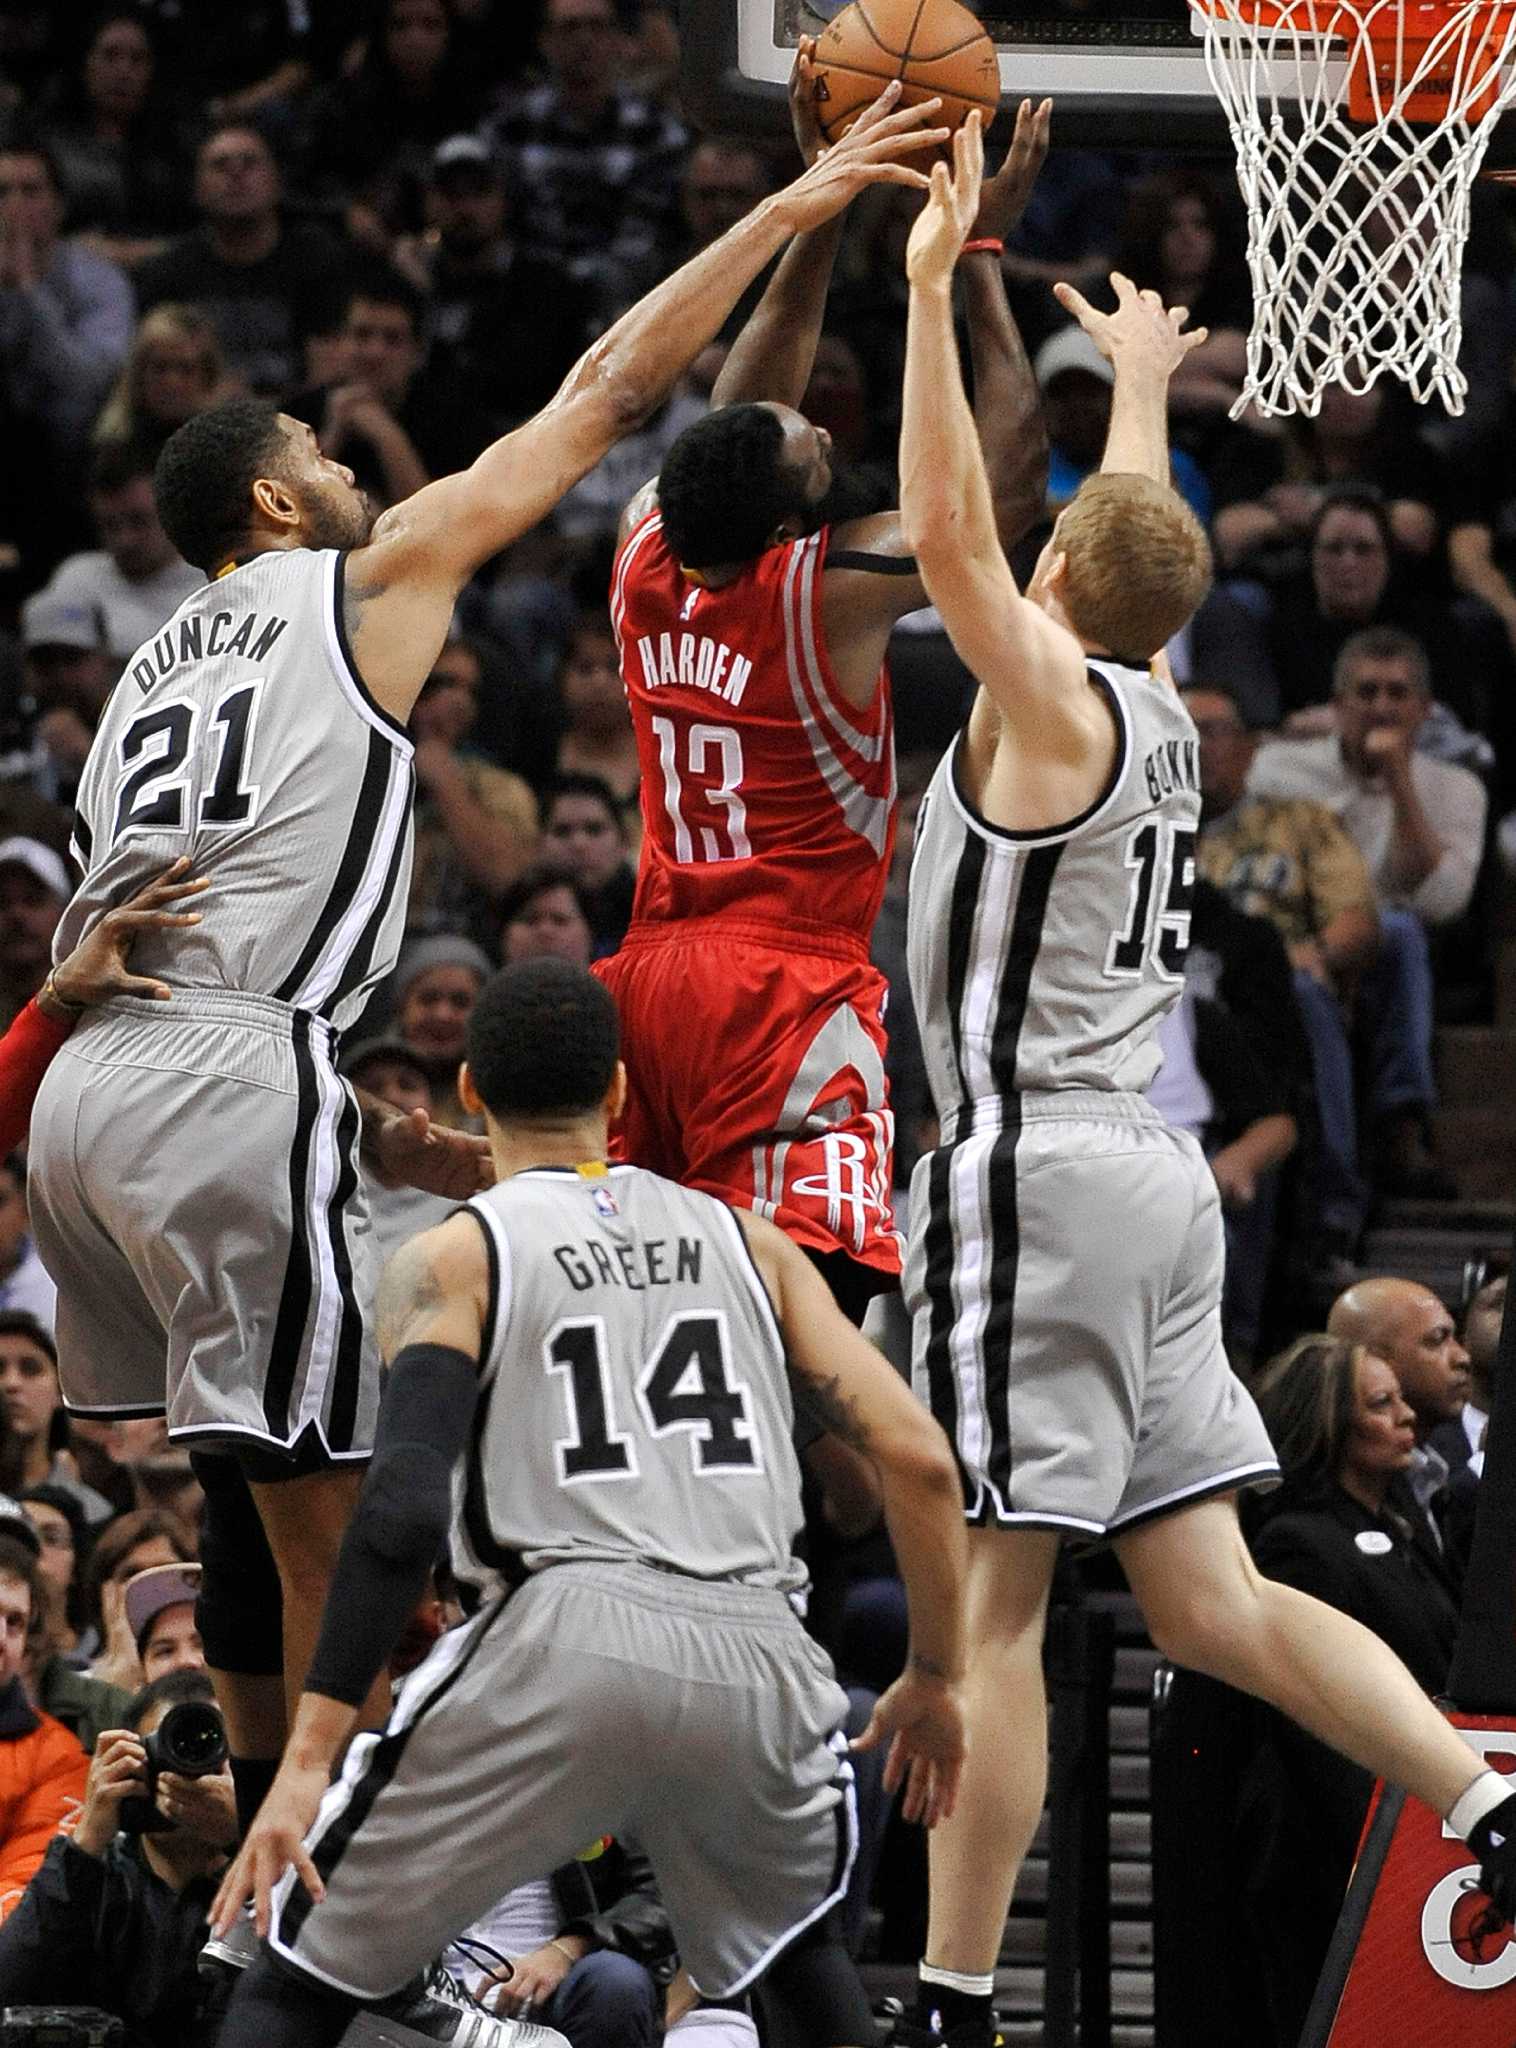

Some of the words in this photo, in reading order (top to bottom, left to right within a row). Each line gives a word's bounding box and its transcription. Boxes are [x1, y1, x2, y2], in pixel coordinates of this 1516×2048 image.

[1366, 78, 1454, 97] SPDING
[133, 612, 287, 695] DUNCAN
[638, 632, 752, 706] HARDEN
[111, 677, 265, 850] 21
[652, 715, 752, 863] 13
[1103, 816, 1198, 982] 15
[554, 1237, 703, 1291] GREEN
[543, 1307, 764, 1487] 14
